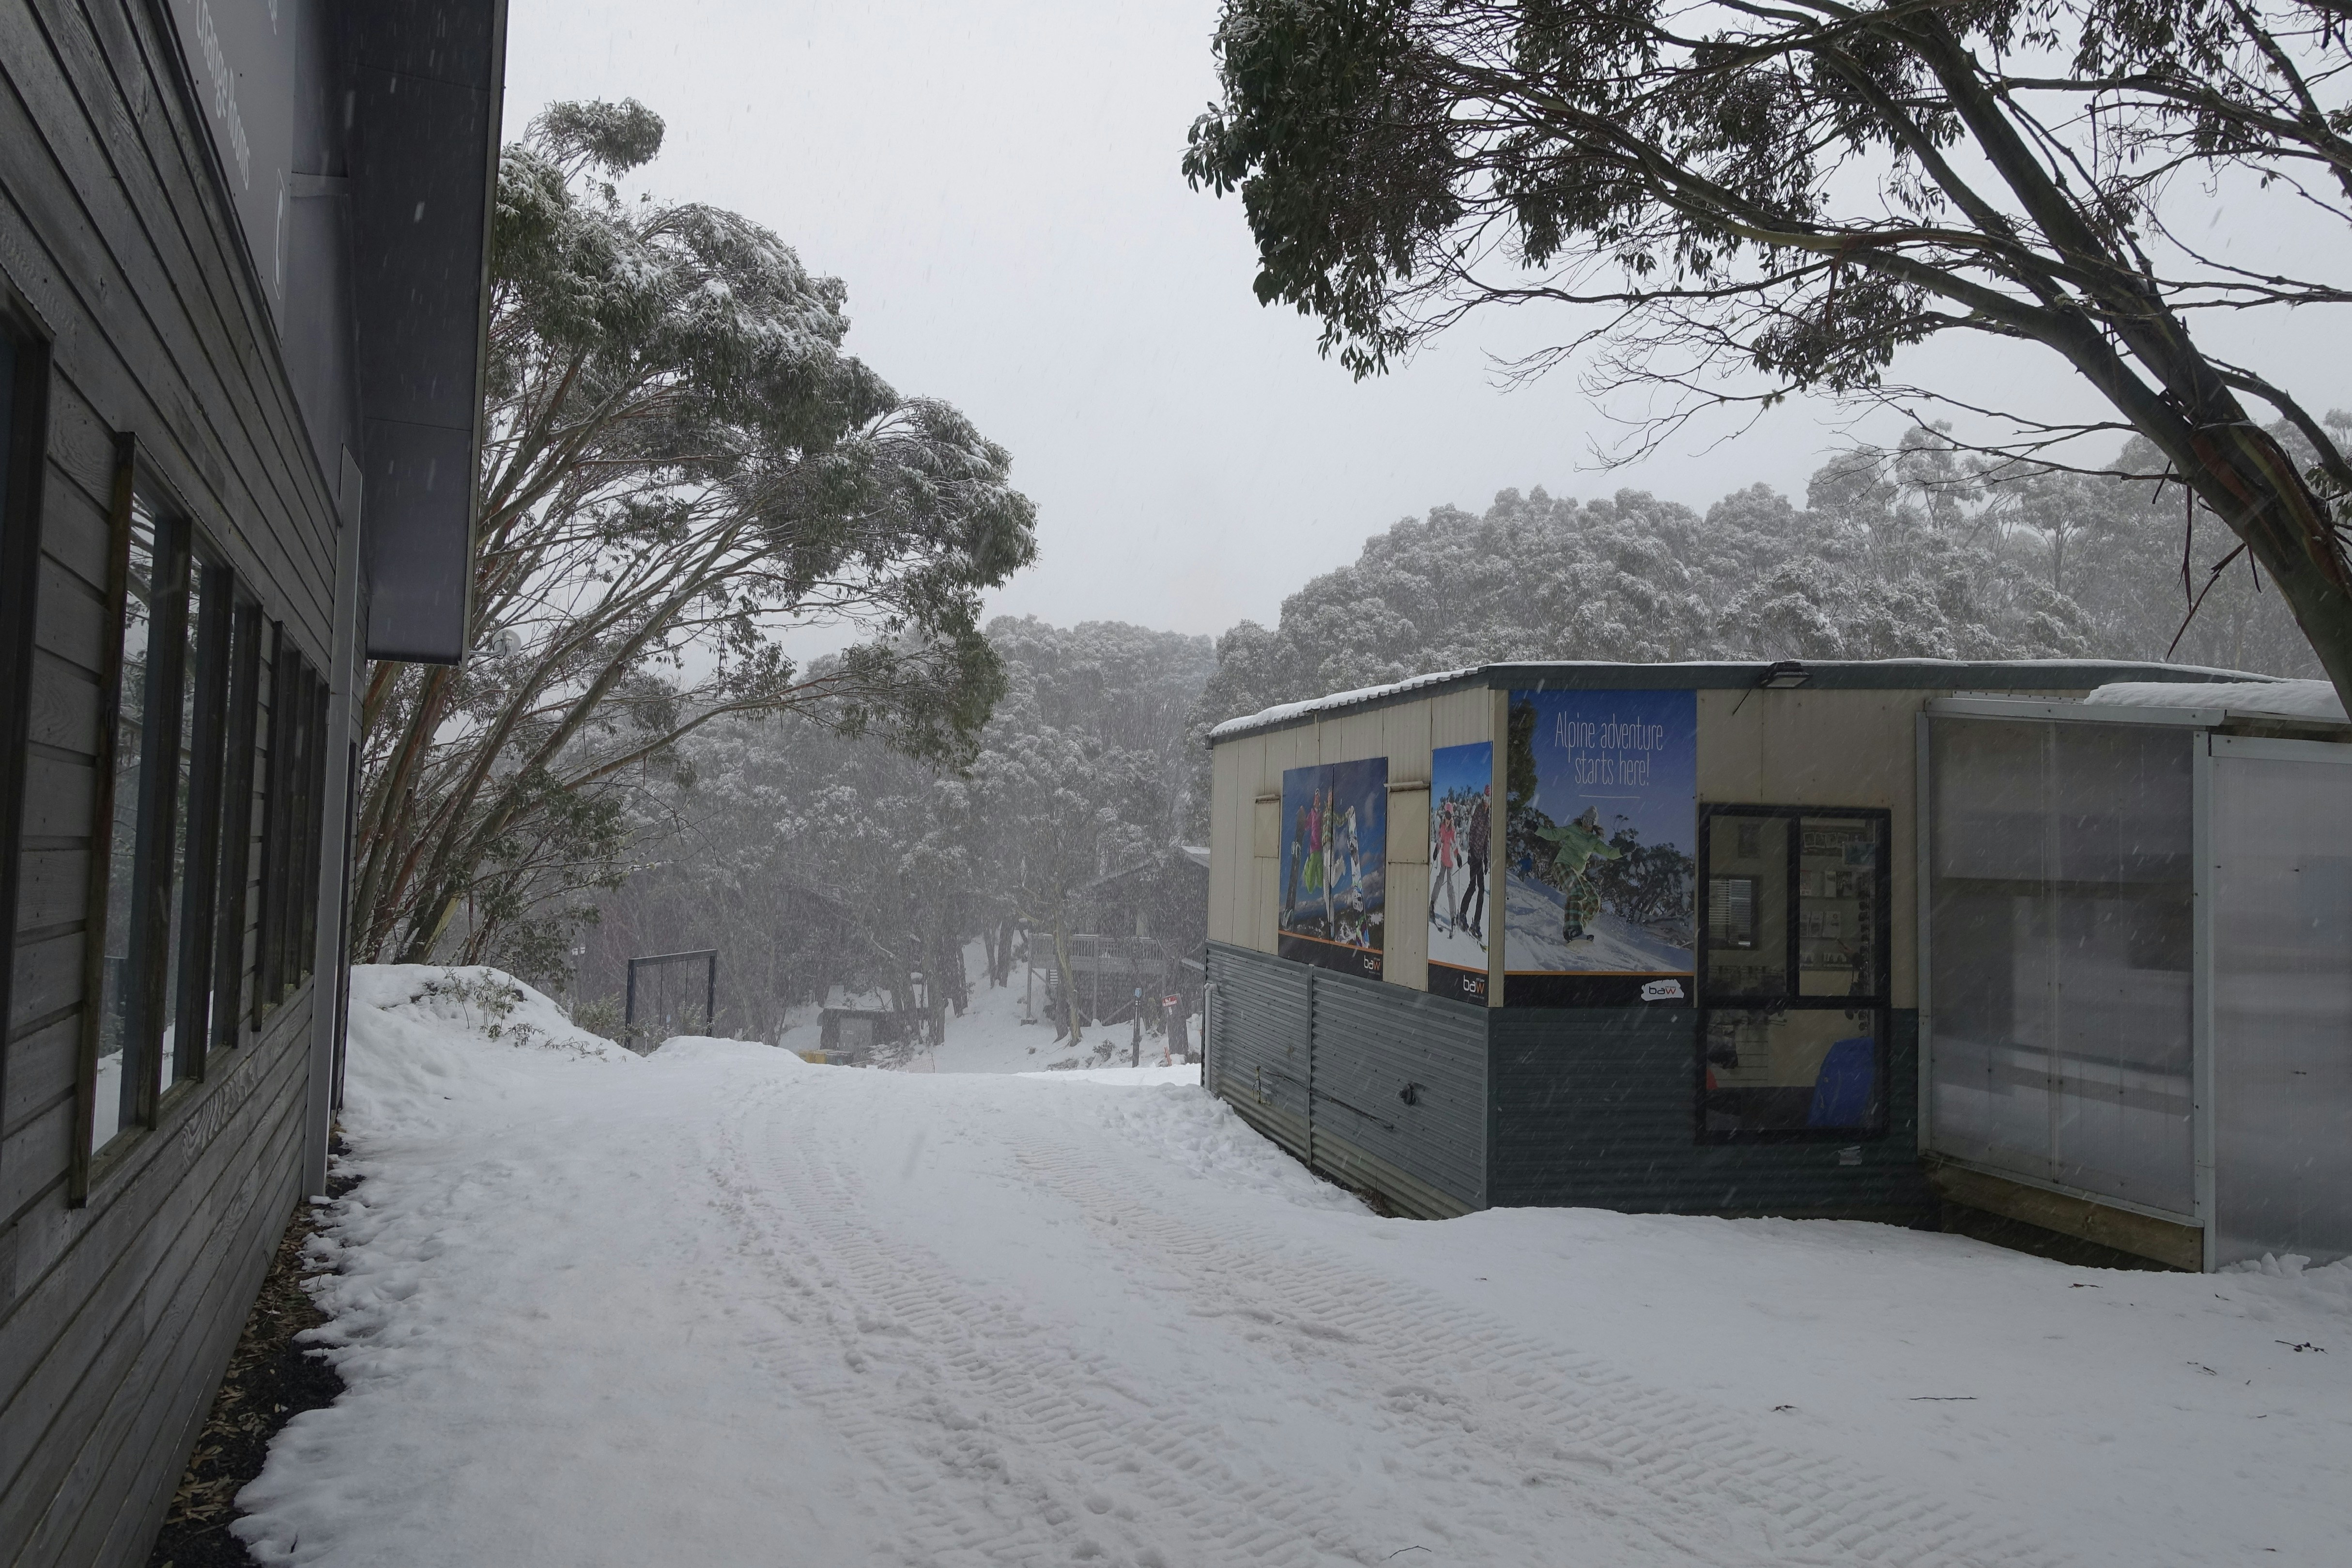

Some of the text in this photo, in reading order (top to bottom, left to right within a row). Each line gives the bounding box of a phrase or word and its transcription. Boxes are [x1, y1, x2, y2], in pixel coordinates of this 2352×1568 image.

[228, 66, 250, 191] Rooms
[1554, 711, 1663, 763] Alpine adventure
[1575, 750, 1650, 786] starts here!
[1364, 954, 1381, 971] baw
[1463, 974, 1485, 994] baw
[1649, 986, 1676, 995] baw
